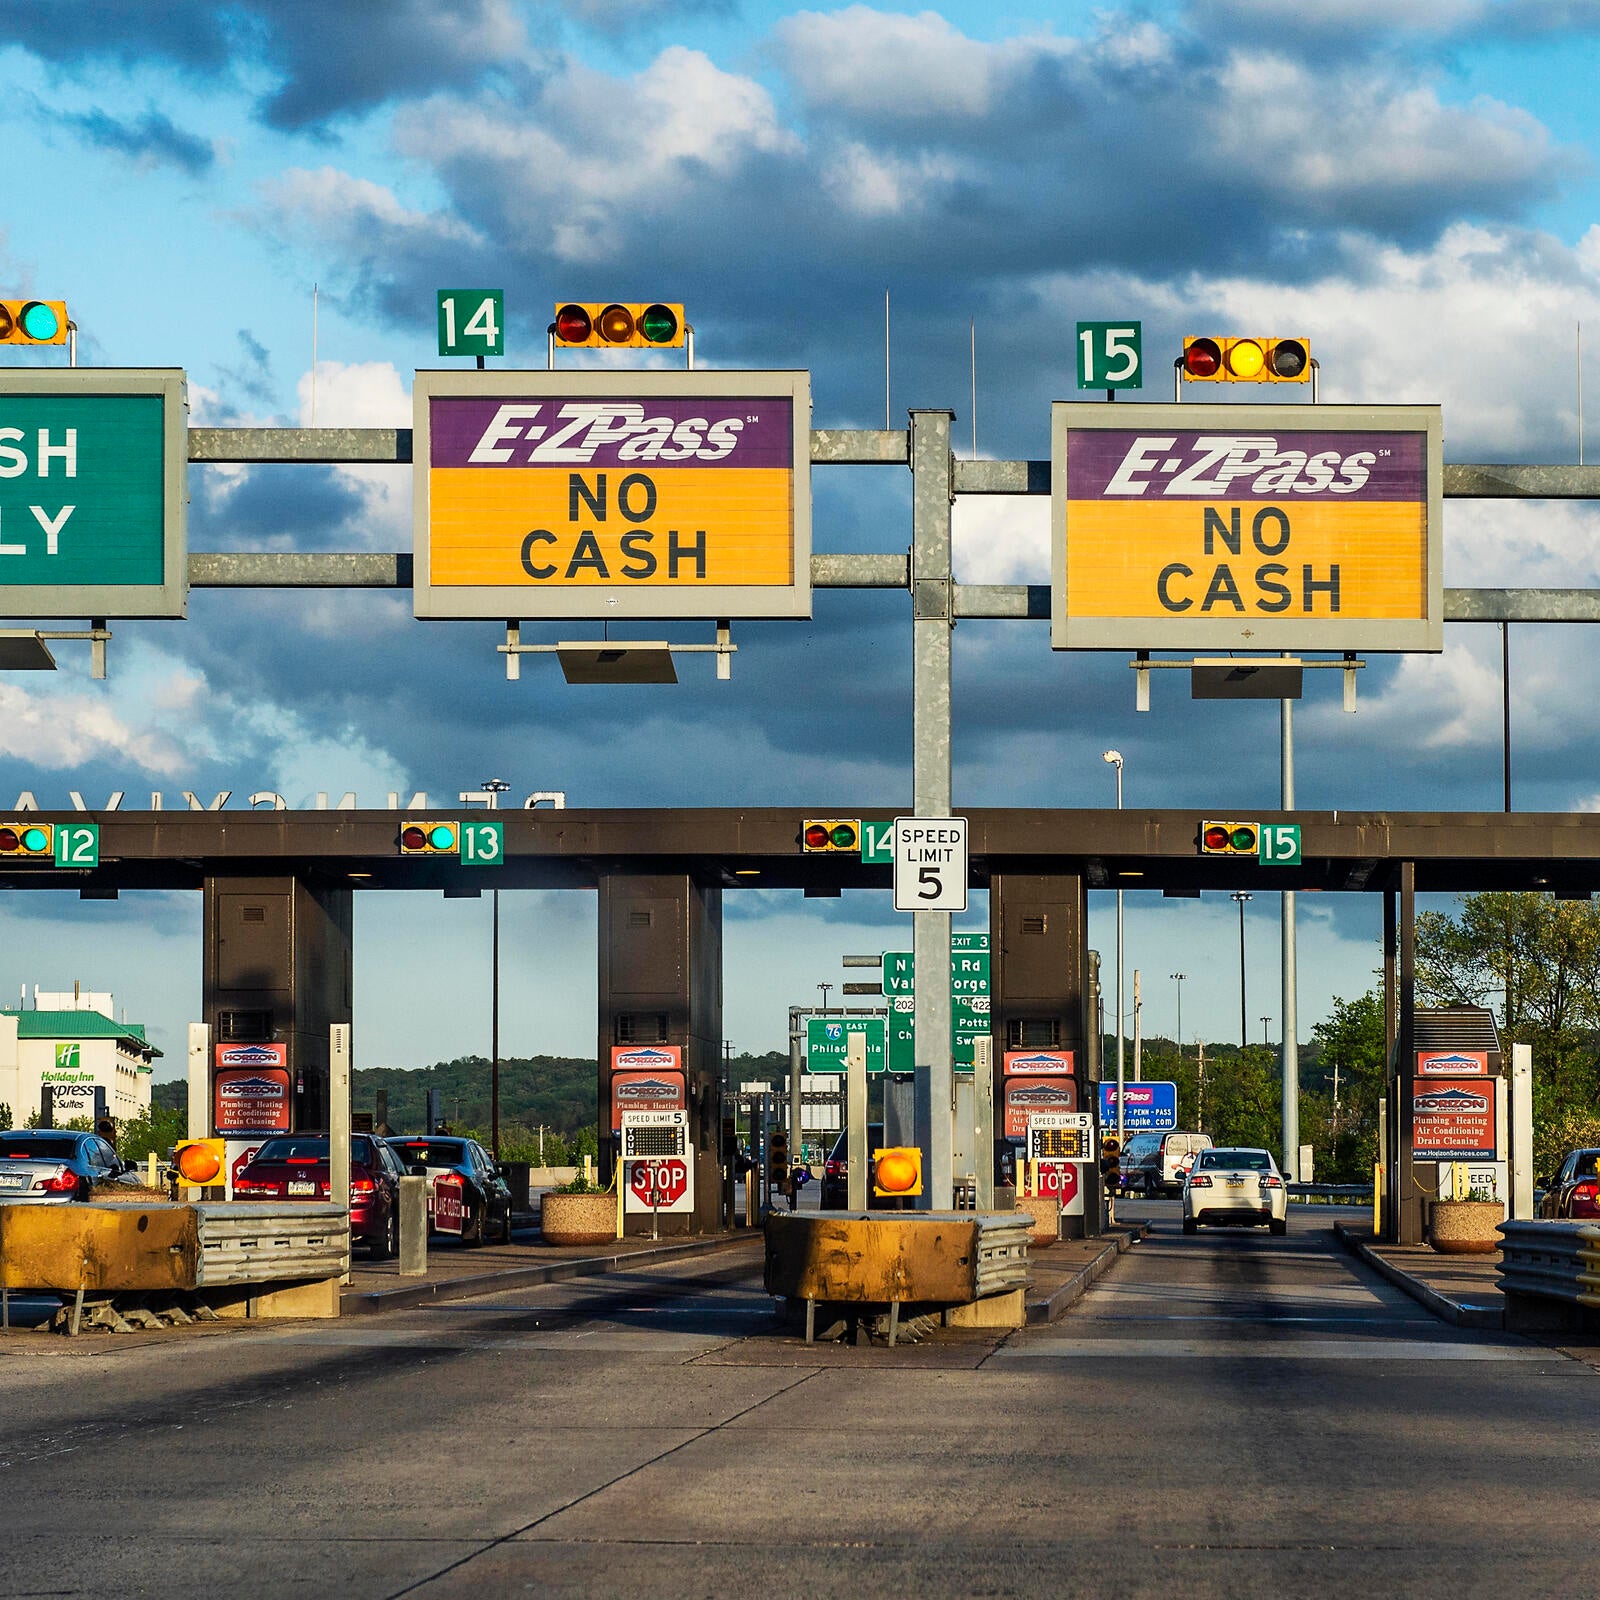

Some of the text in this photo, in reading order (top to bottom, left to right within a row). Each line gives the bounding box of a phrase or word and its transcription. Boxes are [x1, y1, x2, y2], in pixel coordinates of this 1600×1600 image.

[442, 298, 499, 347] 14
[1079, 329, 1139, 382] 15
[467, 403, 744, 463] E-ZPass
[1103, 436, 1377, 495] E-ZPass
[568, 473, 657, 522] NO
[1203, 506, 1291, 556] NO
[520, 529, 706, 579] CASH
[1157, 563, 1341, 612] CASH
[866, 825, 894, 858] 14
[902, 829, 960, 843] SPEED
[60, 829, 95, 862] 12
[466, 826, 498, 860] 13
[1263, 827, 1297, 860] 15
[908, 849, 953, 862] LIMIT
[918, 867, 943, 900] 5
[952, 937, 971, 946] EXIT
[896, 959, 906, 971] N
[961, 959, 980, 971] Rd
[952, 978, 987, 993] orge
[895, 1000, 914, 1010] 202
[972, 1000, 990, 1010] 422
[827, 1027, 840, 1037] 76
[41, 1071, 95, 1083] Holiday Inn
[619, 1087, 677, 1095] HORIZON
[1010, 1093, 1069, 1101] HORIZON
[58, 1100, 84, 1108] Suites
[220, 1101, 283, 1109] Plumbing Heating
[1415, 1099, 1485, 1108] HORIZON
[238, 1109, 281, 1117] Conditioning
[674, 1112, 682, 1124] 5
[1079, 1116, 1087, 1126] 5
[1413, 1116, 1488, 1126] Plumbing Heating
[1417, 1126, 1485, 1136] Air Conditioning
[1045, 1129, 1077, 1155] 15
[1417, 1136, 1479, 1146] Drain Cleaning
[634, 1167, 685, 1189] STOP
